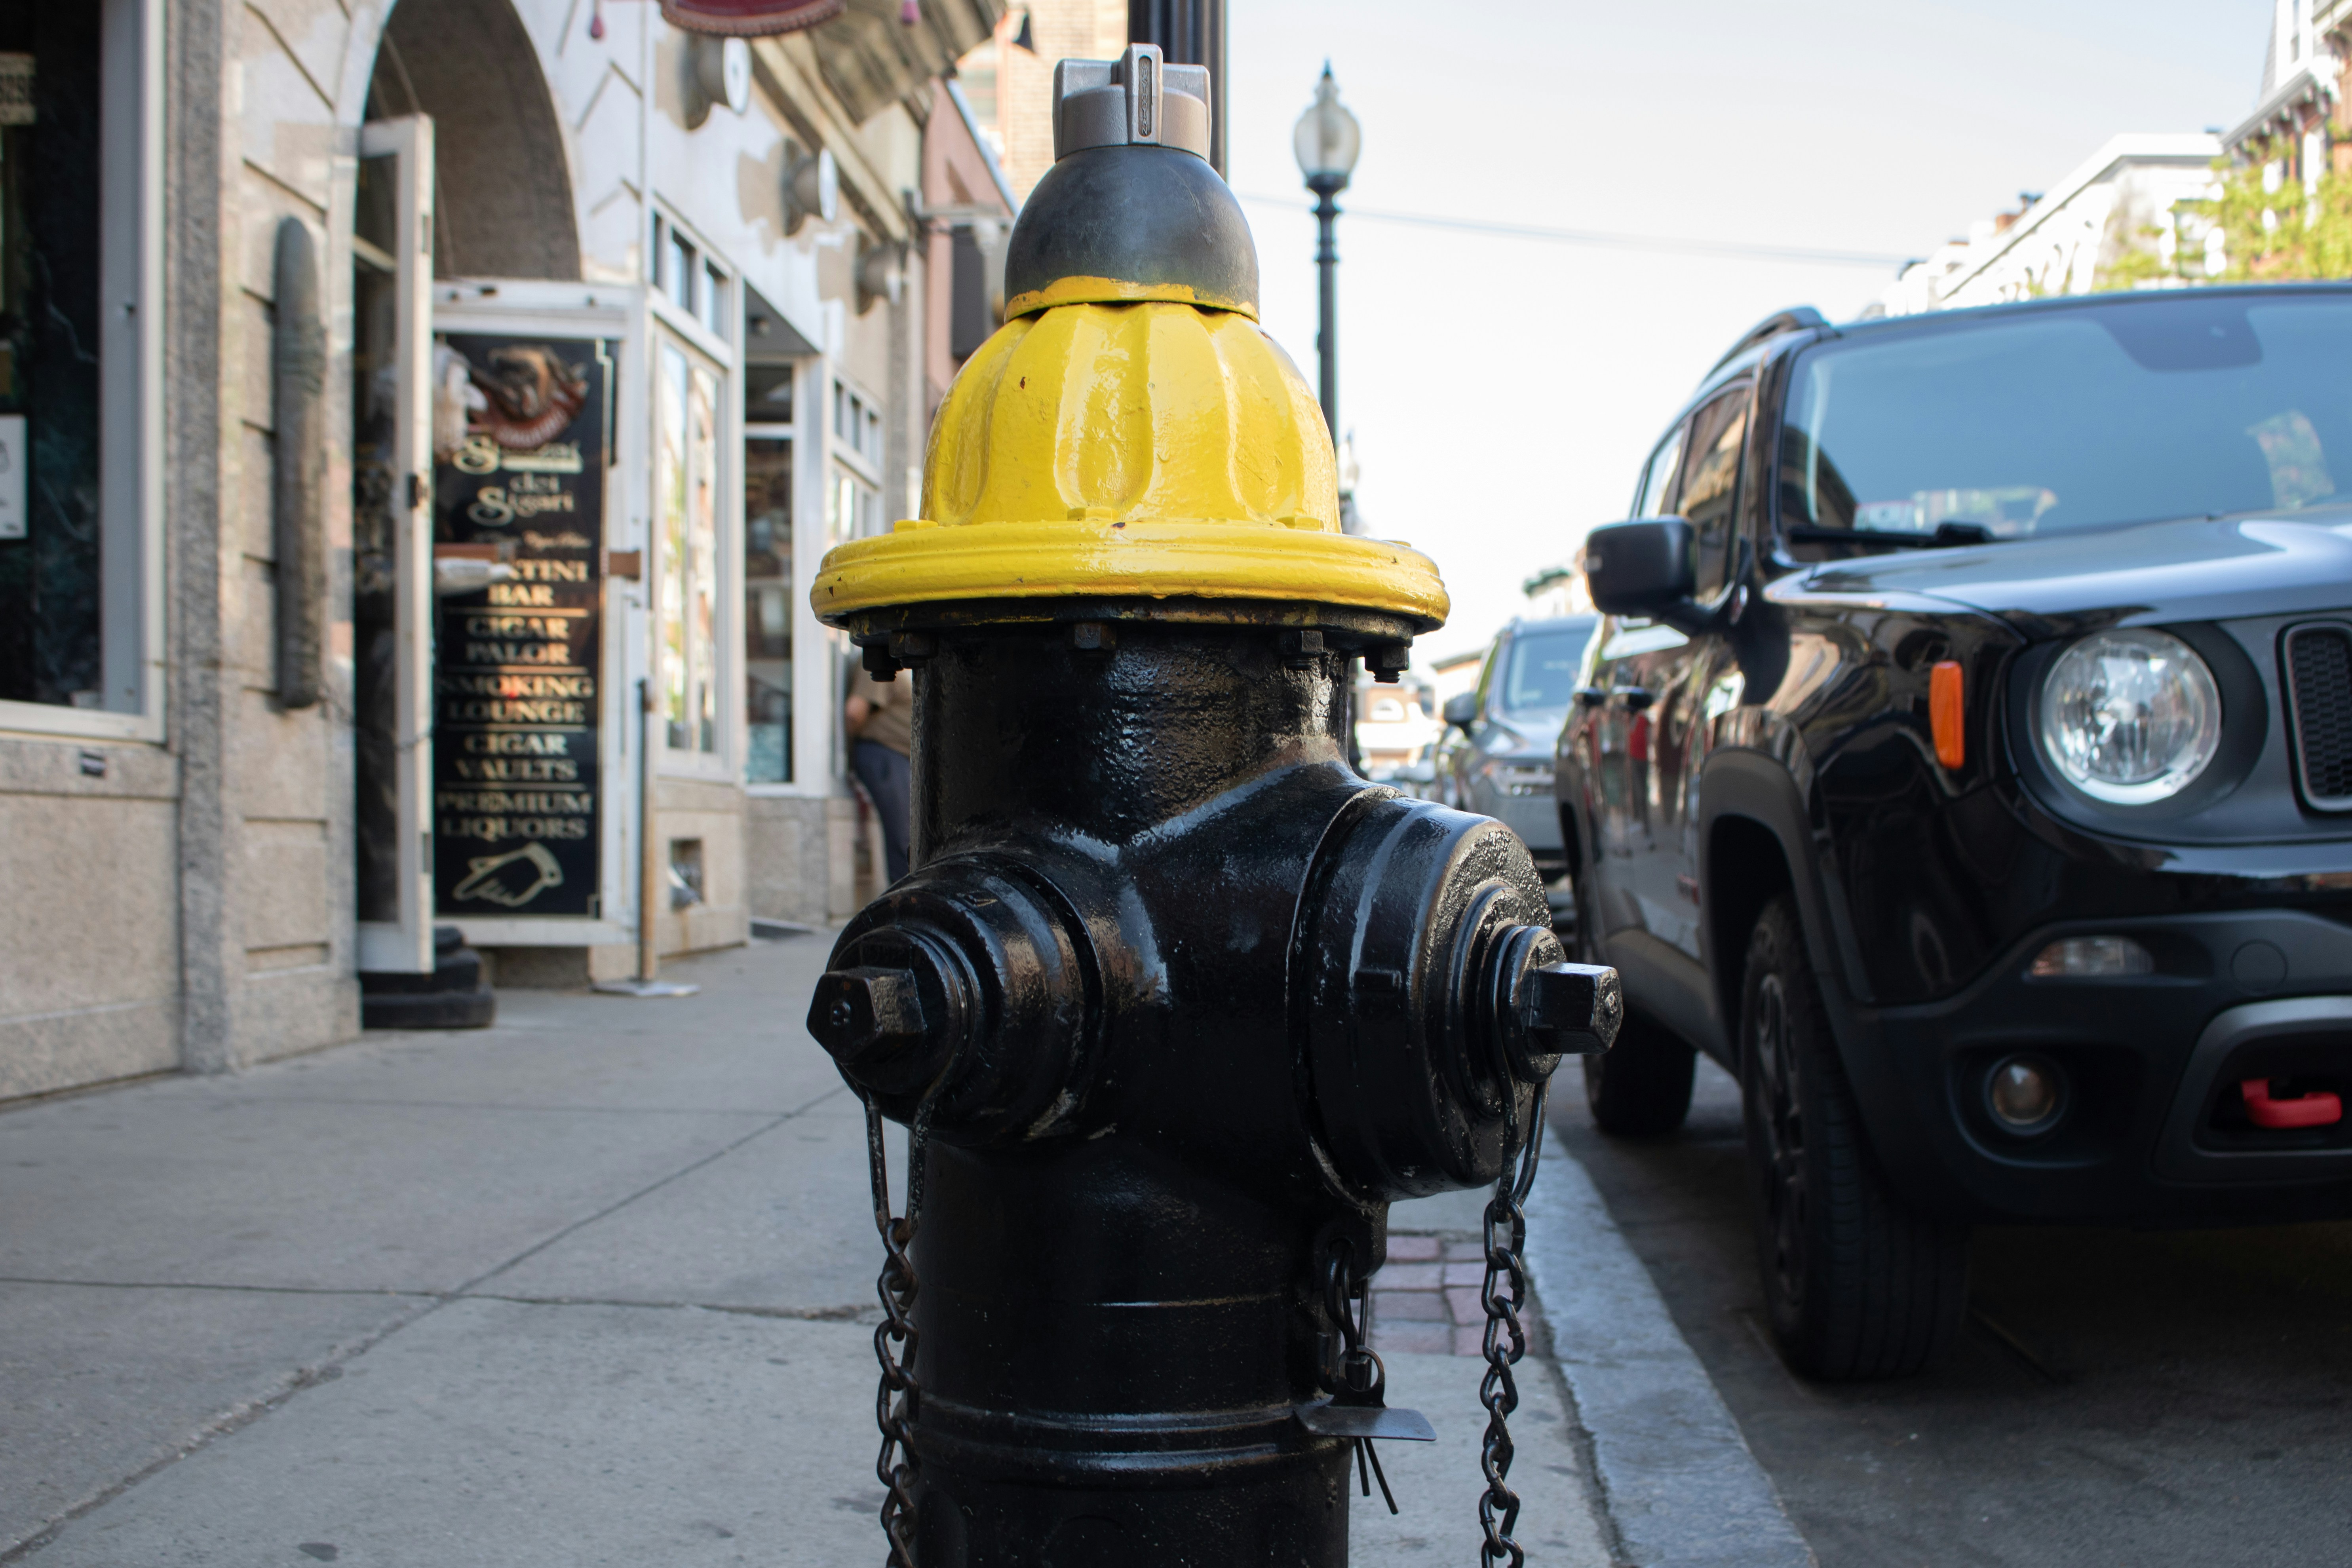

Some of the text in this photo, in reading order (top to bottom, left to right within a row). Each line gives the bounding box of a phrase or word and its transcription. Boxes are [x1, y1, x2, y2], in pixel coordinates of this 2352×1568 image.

[488, 583, 554, 606] BAR
[465, 617, 570, 640] CIGAR
[439, 675, 593, 698] SMOKING
[447, 700, 586, 723] LOUNGE
[464, 733, 567, 755] CIGAR
[454, 758, 578, 781] VAULTS
[436, 791, 593, 814] PREMIUM
[441, 816, 588, 842] LIQUORS
